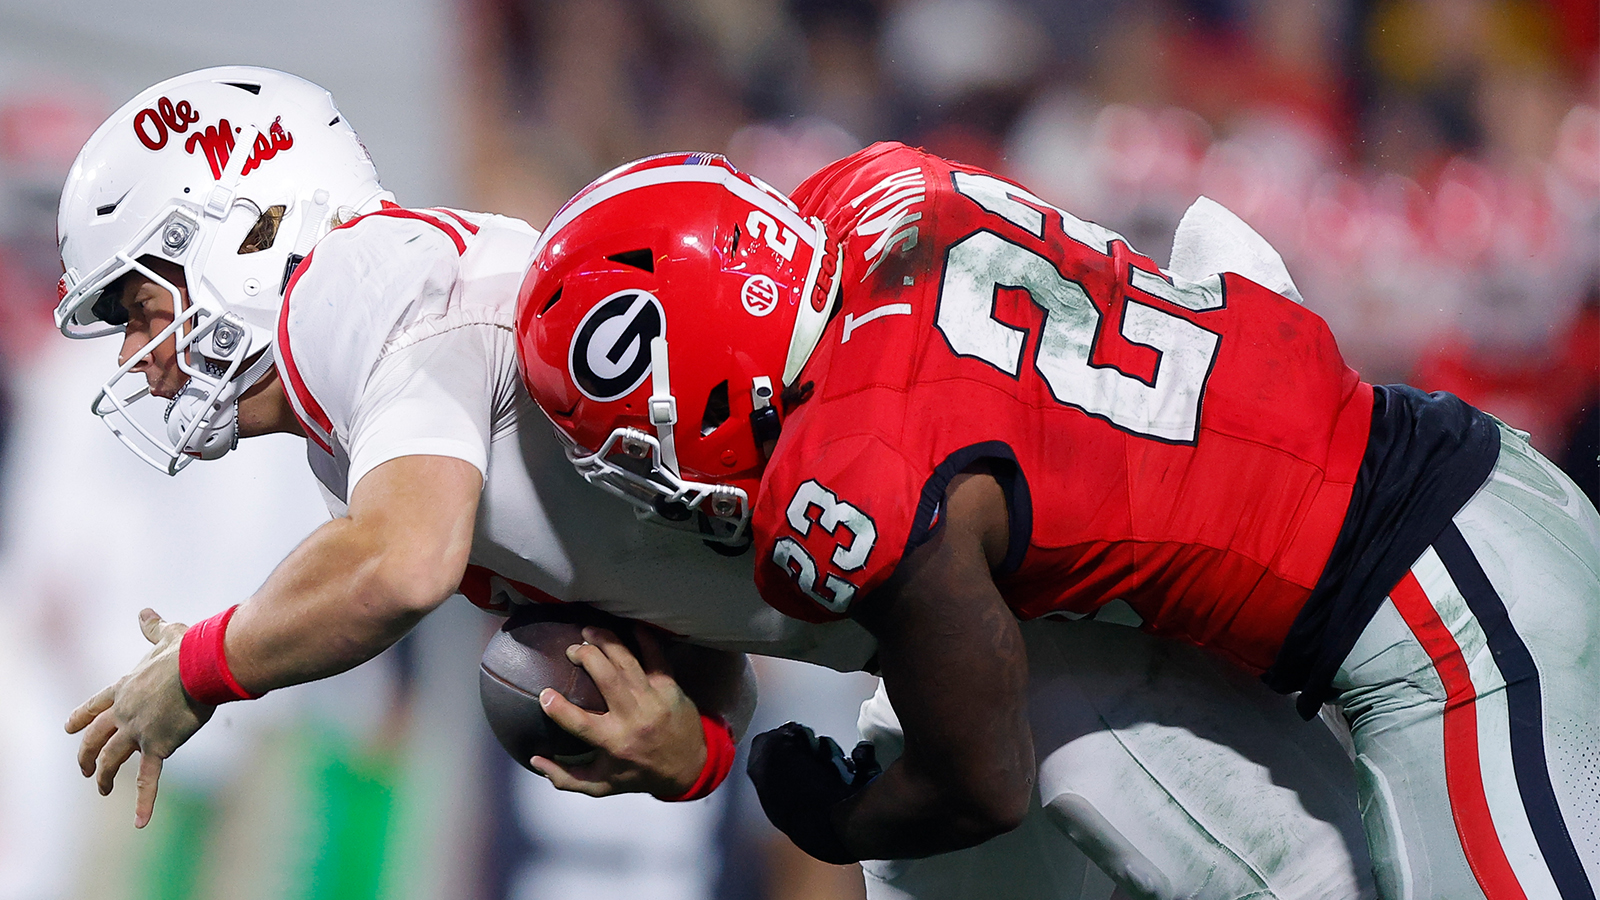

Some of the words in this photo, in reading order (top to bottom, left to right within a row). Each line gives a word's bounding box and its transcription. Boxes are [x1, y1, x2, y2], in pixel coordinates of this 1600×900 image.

[134, 96, 199, 150] Ole
[745, 279, 775, 311] SEC
[772, 478, 879, 614] 23
